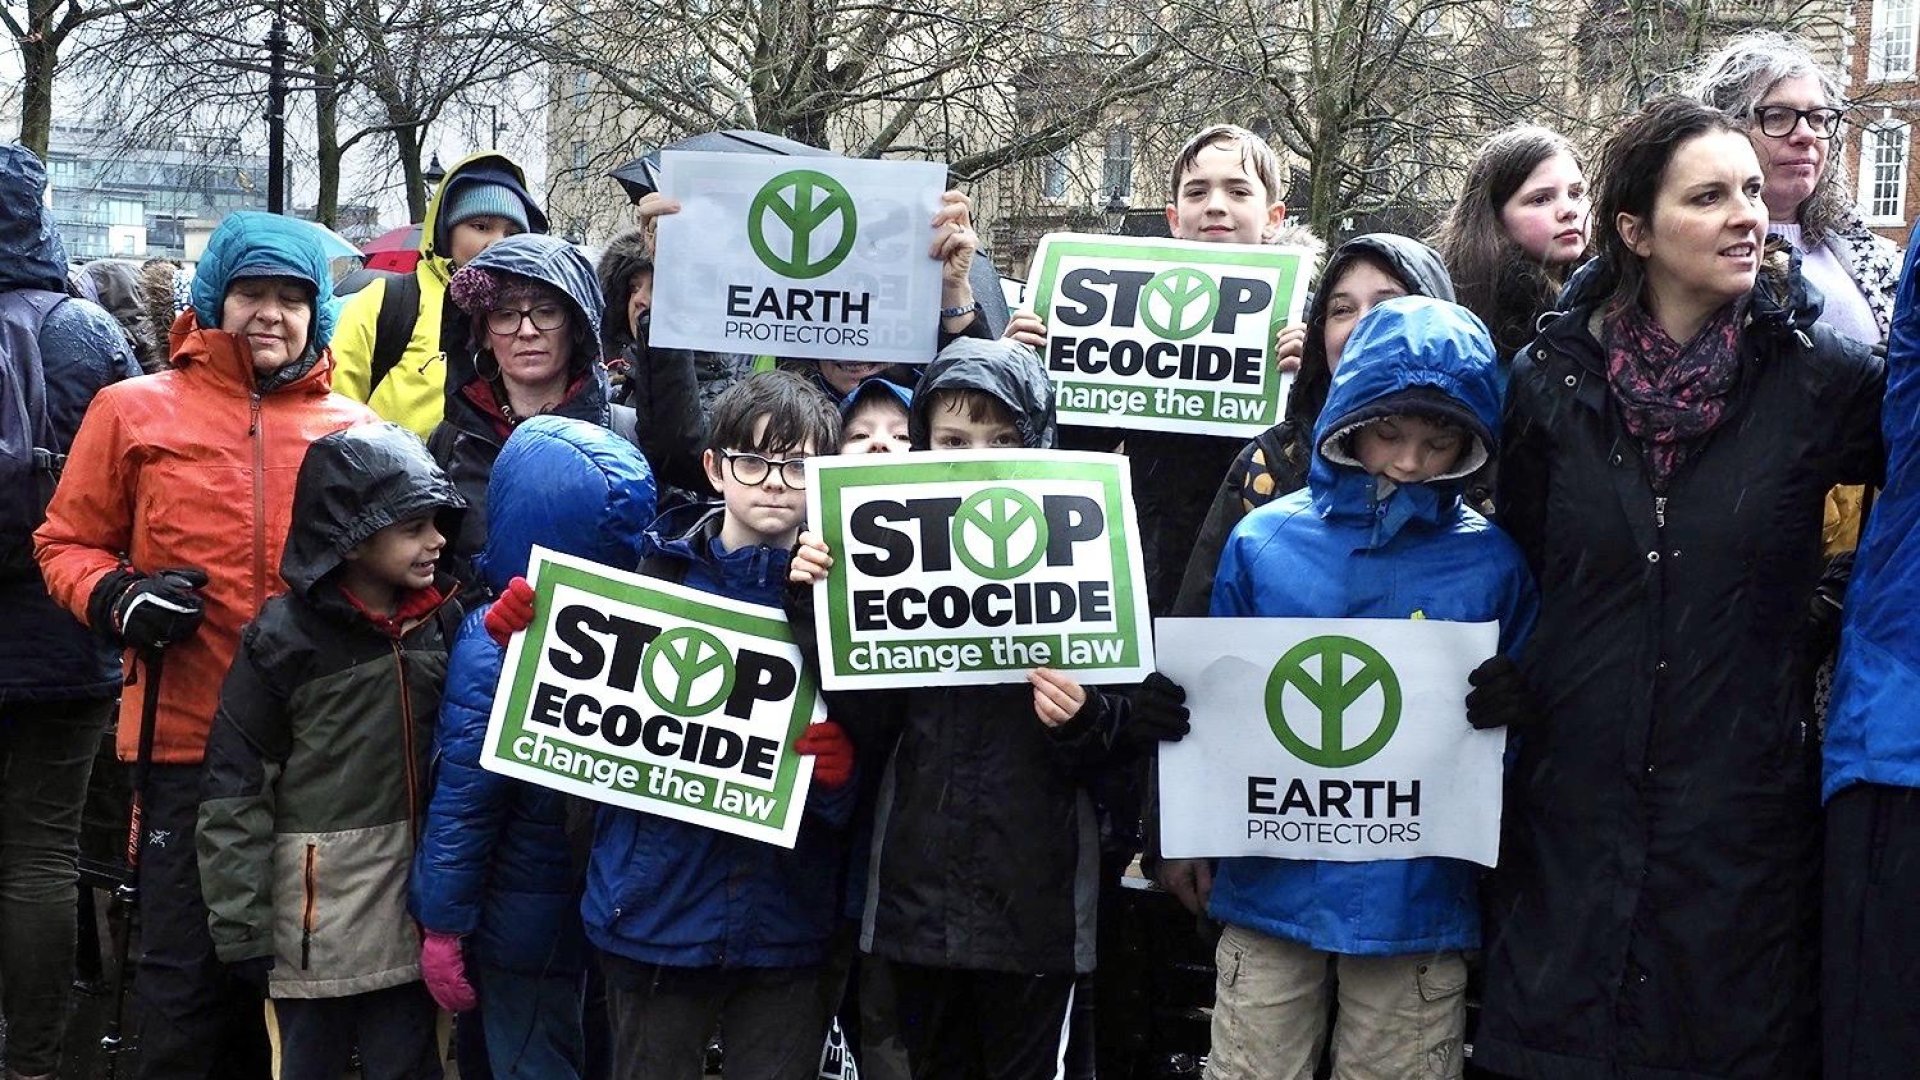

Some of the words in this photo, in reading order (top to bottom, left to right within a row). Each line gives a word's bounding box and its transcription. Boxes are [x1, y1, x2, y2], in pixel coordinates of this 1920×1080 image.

[727, 285, 870, 324] EARTH
[1056, 267, 1272, 340] STOP
[725, 321, 869, 346] PROTECTORS
[1049, 336, 1262, 384] ECOCIDE
[1052, 380, 1147, 415] hange
[1154, 386, 1205, 416] the
[1212, 391, 1267, 421] law
[850, 487, 1104, 580] STOP
[853, 581, 1112, 631] ECOCIDE
[548, 605, 797, 720] STOP
[849, 638, 983, 672] change
[991, 636, 1052, 665] the
[1061, 634, 1125, 665] law
[530, 682, 779, 779] ECOCIDE
[512, 731, 640, 787] change
[648, 764, 705, 803] the
[713, 779, 777, 820] law
[1247, 776, 1421, 818] EARTH
[1247, 820, 1421, 844] PROTECTORS
